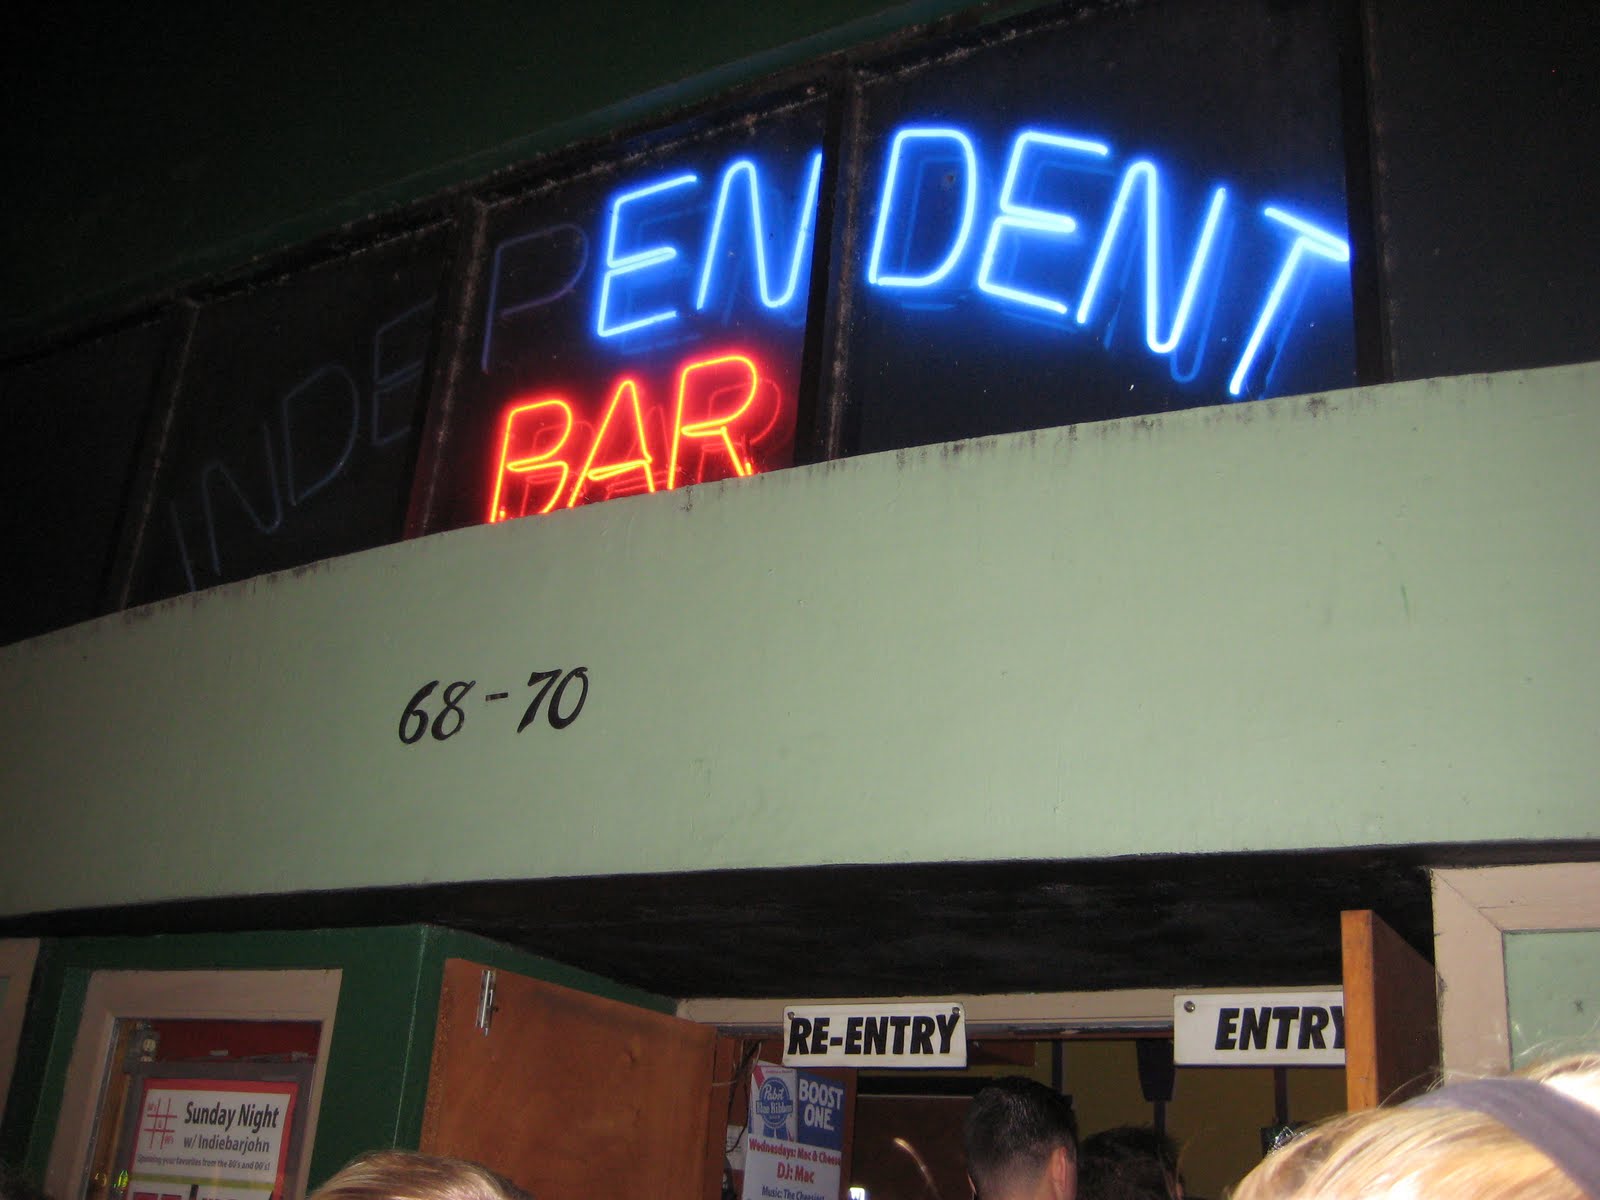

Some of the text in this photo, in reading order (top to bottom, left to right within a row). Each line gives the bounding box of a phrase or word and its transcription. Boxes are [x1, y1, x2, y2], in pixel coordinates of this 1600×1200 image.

[487, 354, 758, 524] BAR
[787, 1014, 960, 1055] RE-ENTRY
[764, 1084, 784, 1100] Pabst
[799, 1079, 844, 1110] BOOST
[184, 1101, 279, 1133] Sunday Night
[804, 1105, 835, 1131] ONE
[184, 1134, 197, 1149] w/
[198, 1134, 270, 1156] Indiebarjohn
[749, 1138, 796, 1160] Wednesdays:
[797, 1148, 811, 1161] Mac
[202, 1157, 216, 1167] from
[218, 1159, 227, 1168] the
[242, 1160, 254, 1169] and
[795, 1165, 815, 1184] Mac
[762, 1185, 783, 1198] Music:
[784, 1188, 795, 1200] The
